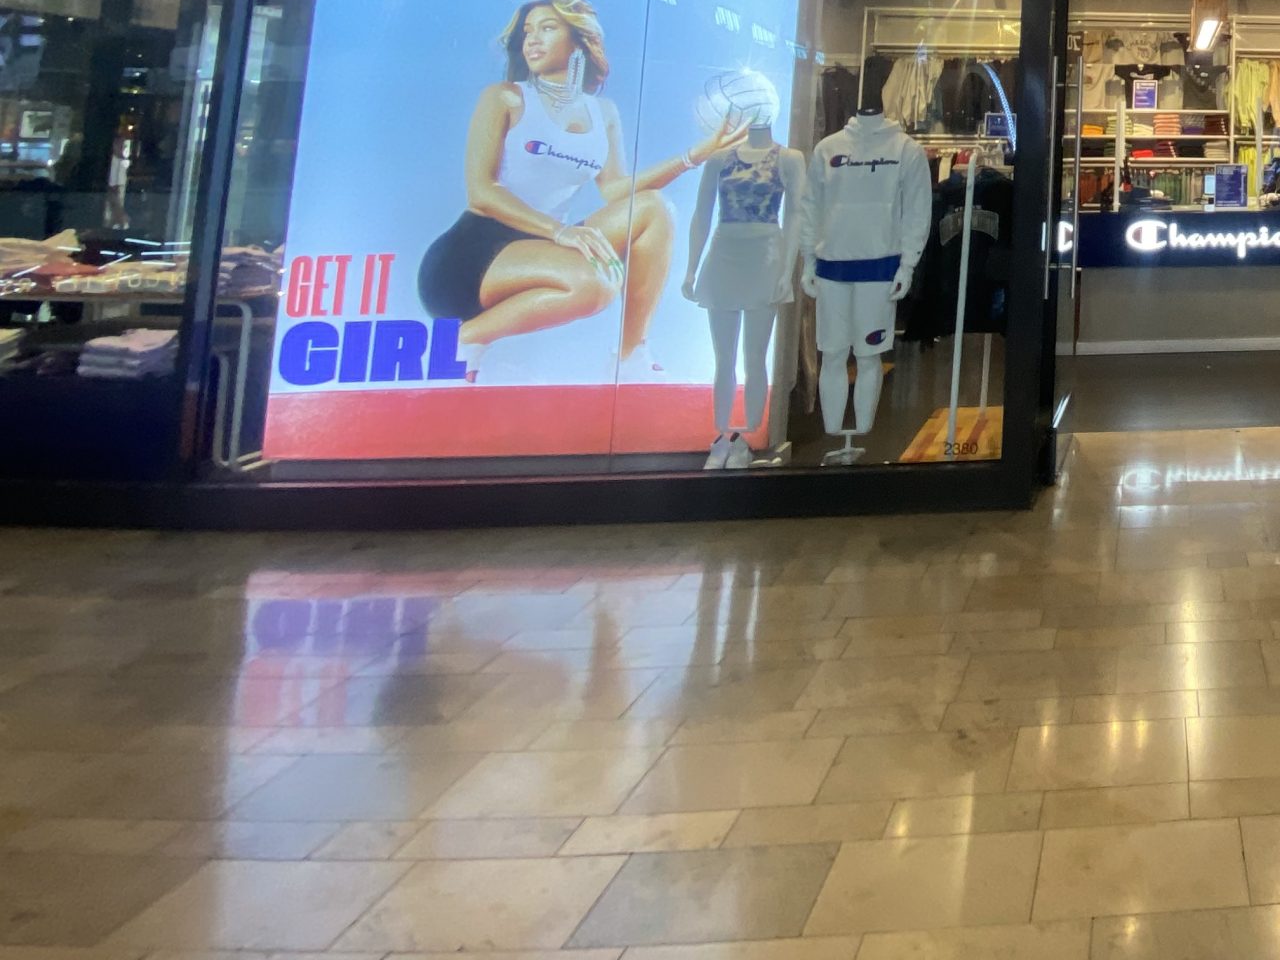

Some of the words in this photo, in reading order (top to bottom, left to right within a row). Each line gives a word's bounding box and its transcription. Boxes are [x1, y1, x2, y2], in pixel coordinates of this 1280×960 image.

[524, 140, 603, 169] Champio
[829, 154, 900, 173] Champion
[286, 254, 353, 318] GET
[359, 253, 396, 315] IT
[278, 318, 467, 386] GIRL
[943, 440, 979, 456] 2380
